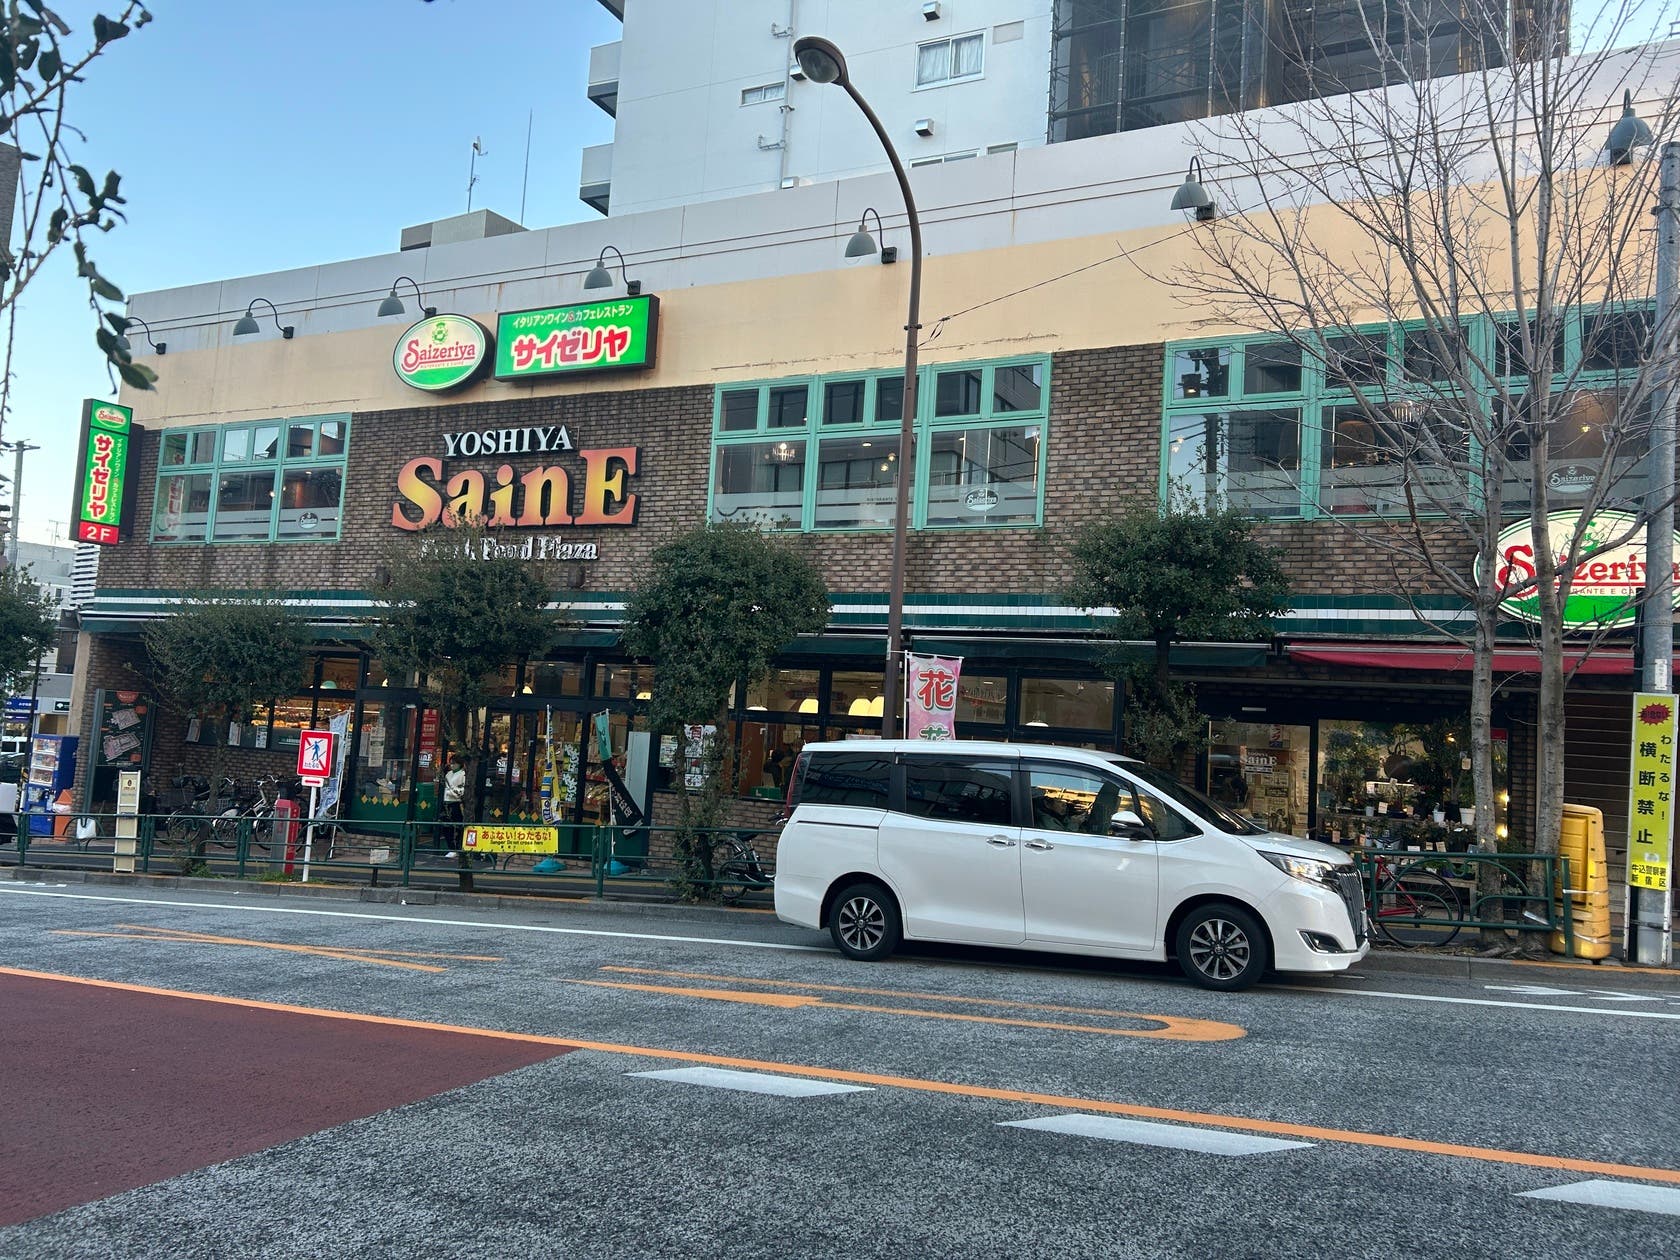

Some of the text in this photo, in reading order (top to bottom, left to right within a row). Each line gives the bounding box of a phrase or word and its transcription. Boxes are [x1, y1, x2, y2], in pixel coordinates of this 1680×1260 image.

[513, 304, 633, 328] イタリアンワイン&カフェレストラン
[401, 338, 476, 373] Saizeriya
[512, 328, 630, 368] サイゼリヤ
[443, 424, 574, 458] YOSHIYA
[88, 434, 114, 518] サイゼリヤ
[391, 446, 637, 532] SainE
[86, 526, 111, 541] 2F
[536, 534, 598, 561] Plaza
[917, 668, 956, 711] 花
[1636, 741, 1657, 845] 横断禁止
